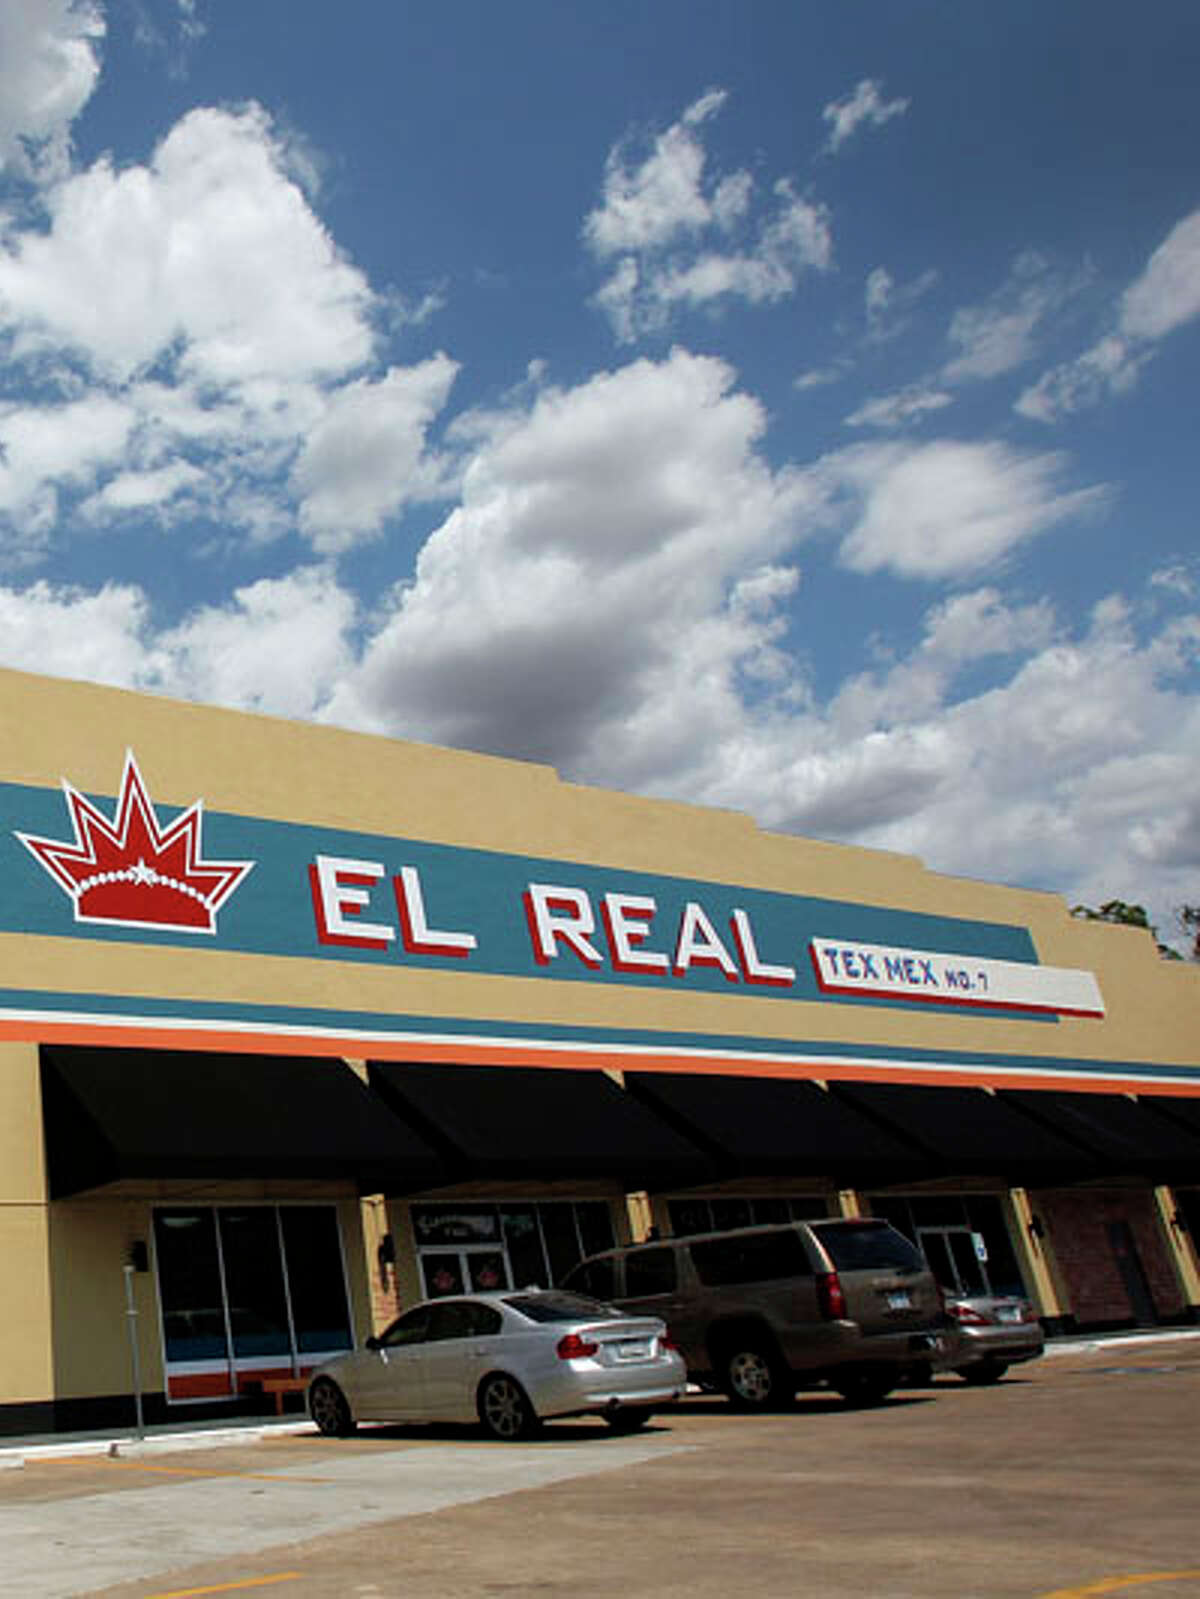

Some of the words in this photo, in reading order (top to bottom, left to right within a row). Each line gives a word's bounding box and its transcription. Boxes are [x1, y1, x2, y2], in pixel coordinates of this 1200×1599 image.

[308, 854, 478, 959] EL
[522, 882, 797, 985] REAL
[823, 948, 879, 980] TEX
[883, 955, 939, 987] MEX
